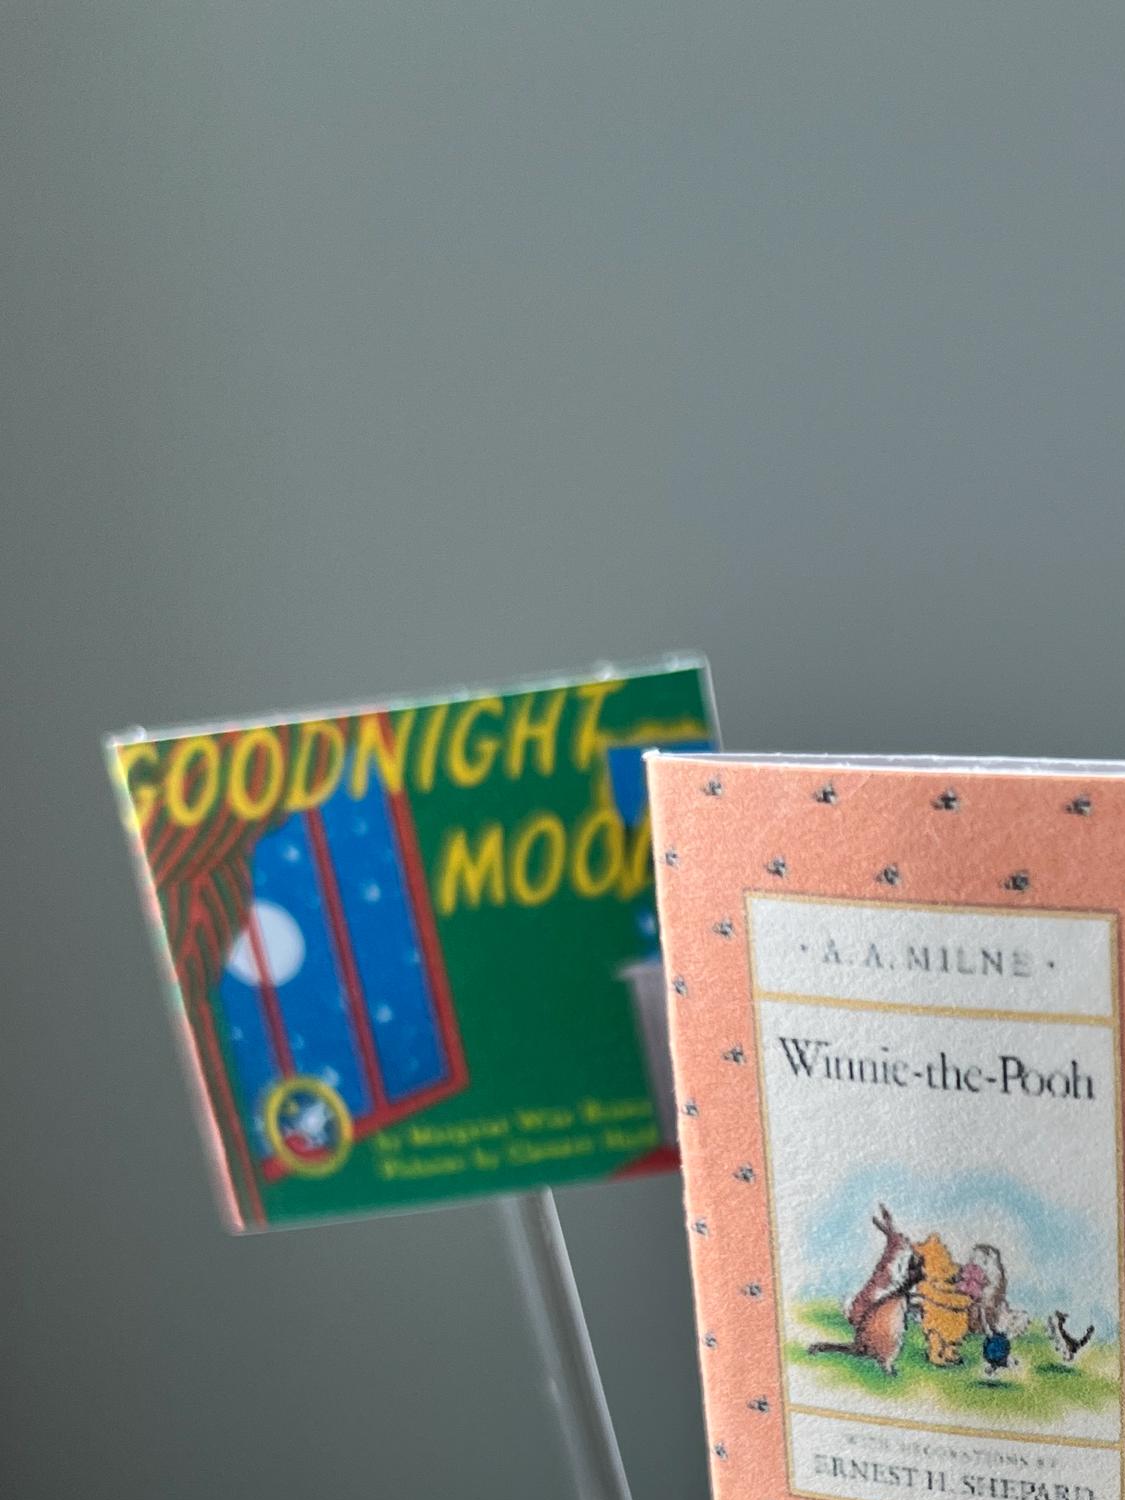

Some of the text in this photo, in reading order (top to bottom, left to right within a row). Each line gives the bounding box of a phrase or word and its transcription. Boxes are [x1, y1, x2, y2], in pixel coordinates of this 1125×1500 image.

[116, 679, 628, 832] GOODNIGHT
[906, 945, 1034, 979] MILNE
[778, 1035, 1097, 1100] Winnie-the-Pooh
[815, 1453, 919, 1489] ERNEST
